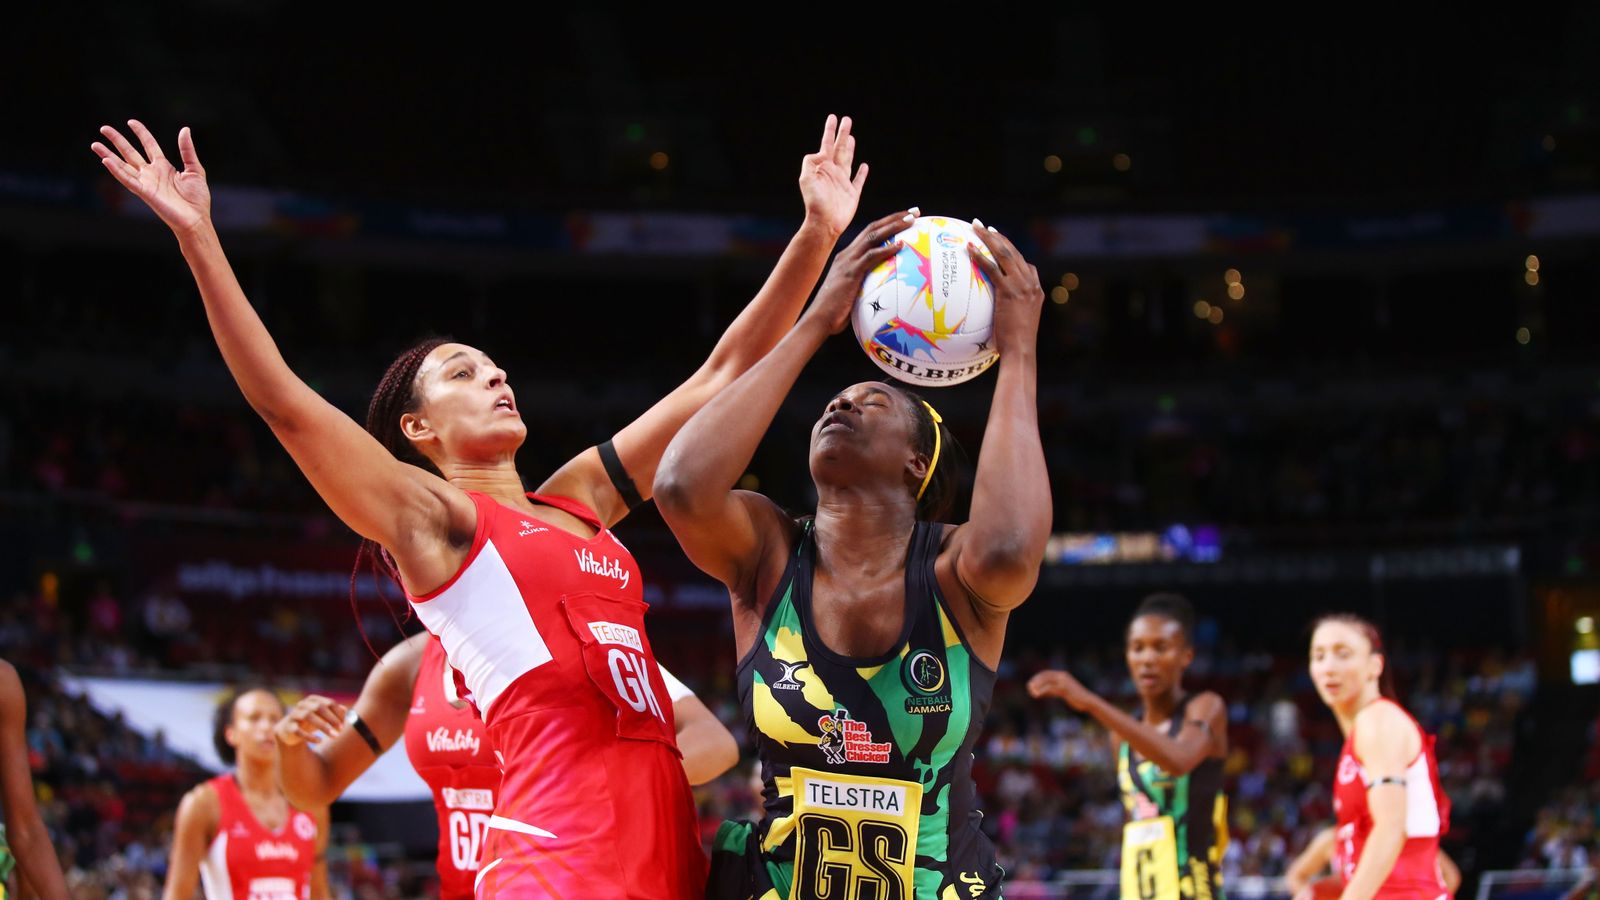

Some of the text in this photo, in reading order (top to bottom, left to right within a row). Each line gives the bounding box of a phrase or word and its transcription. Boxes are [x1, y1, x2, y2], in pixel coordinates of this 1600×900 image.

[942, 250, 950, 298] WORLD CUP
[950, 250, 958, 284] NETBALL
[574, 548, 630, 589] Vitality
[592, 625, 641, 647] TELSTRA
[607, 648, 666, 724] GK
[773, 682, 801, 691] GILBERT
[907, 696, 951, 706] NETBALL
[908, 704, 951, 714] JAMAICA
[843, 720, 866, 732] The
[844, 732, 870, 742] Best
[426, 726, 480, 757] Vitality
[845, 742, 890, 752] Dressed
[845, 752, 889, 763] Chicken
[809, 782, 899, 812] TELSTRA
[797, 813, 909, 900] GS
